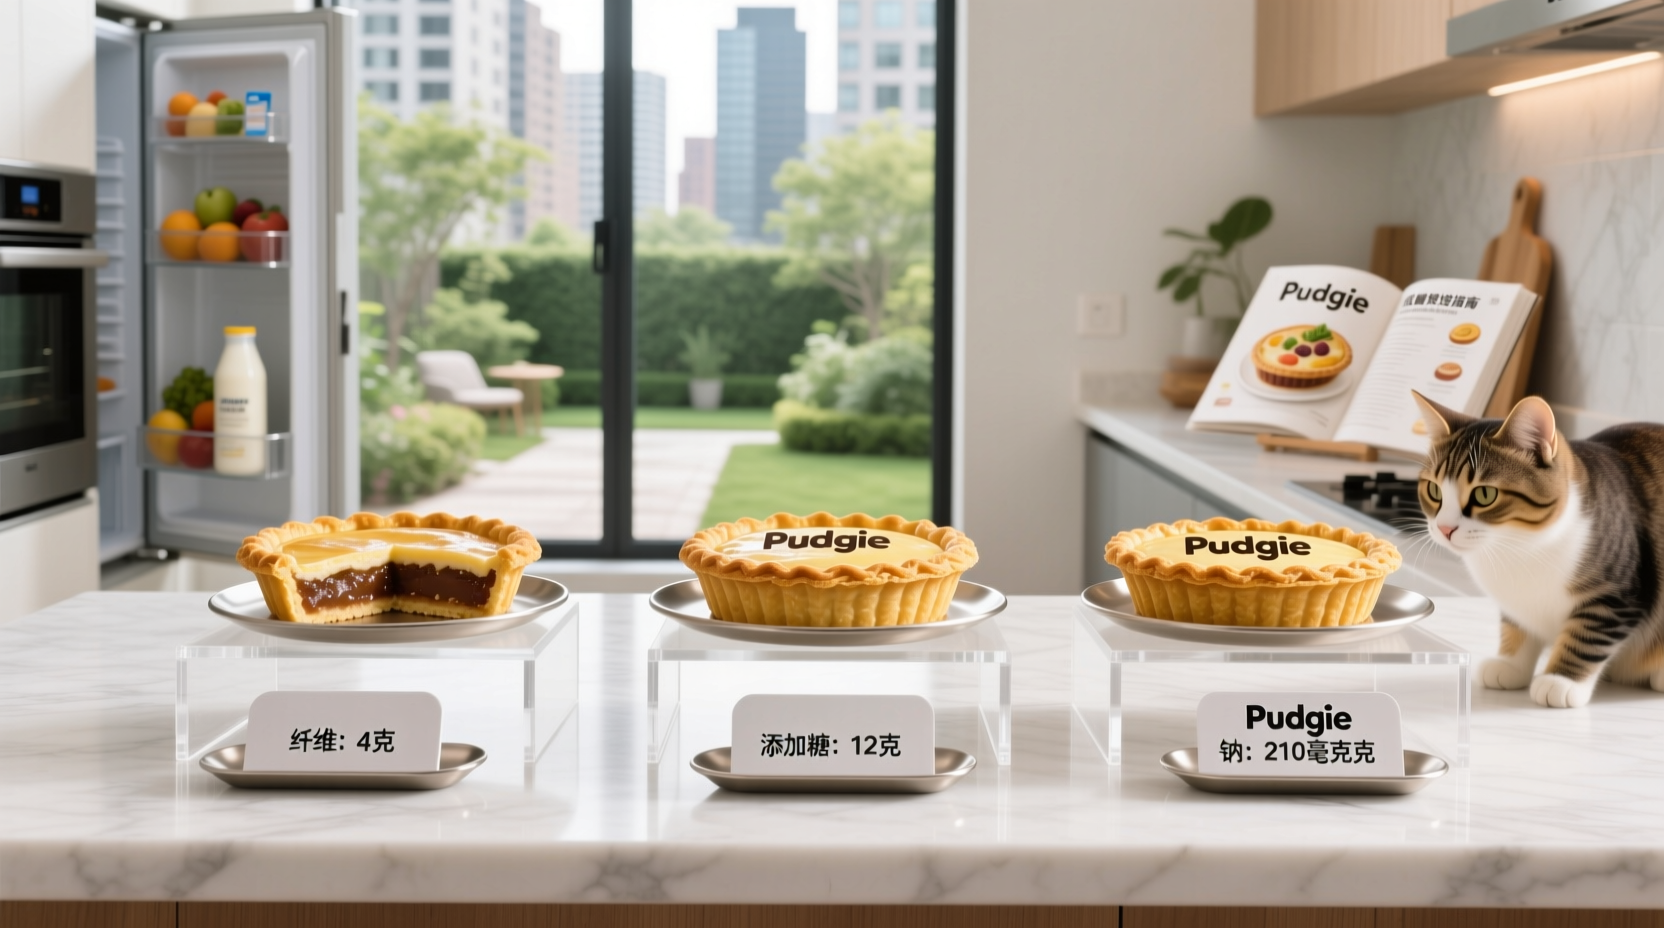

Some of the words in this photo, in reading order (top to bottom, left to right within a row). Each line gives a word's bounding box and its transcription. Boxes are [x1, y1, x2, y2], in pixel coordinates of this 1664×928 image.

[1279, 281, 1369, 314] Pudgie
[763, 529, 891, 554] Pudgie
[1184, 535, 1312, 561] Pudgie
[1246, 703, 1353, 738] Pudgie
